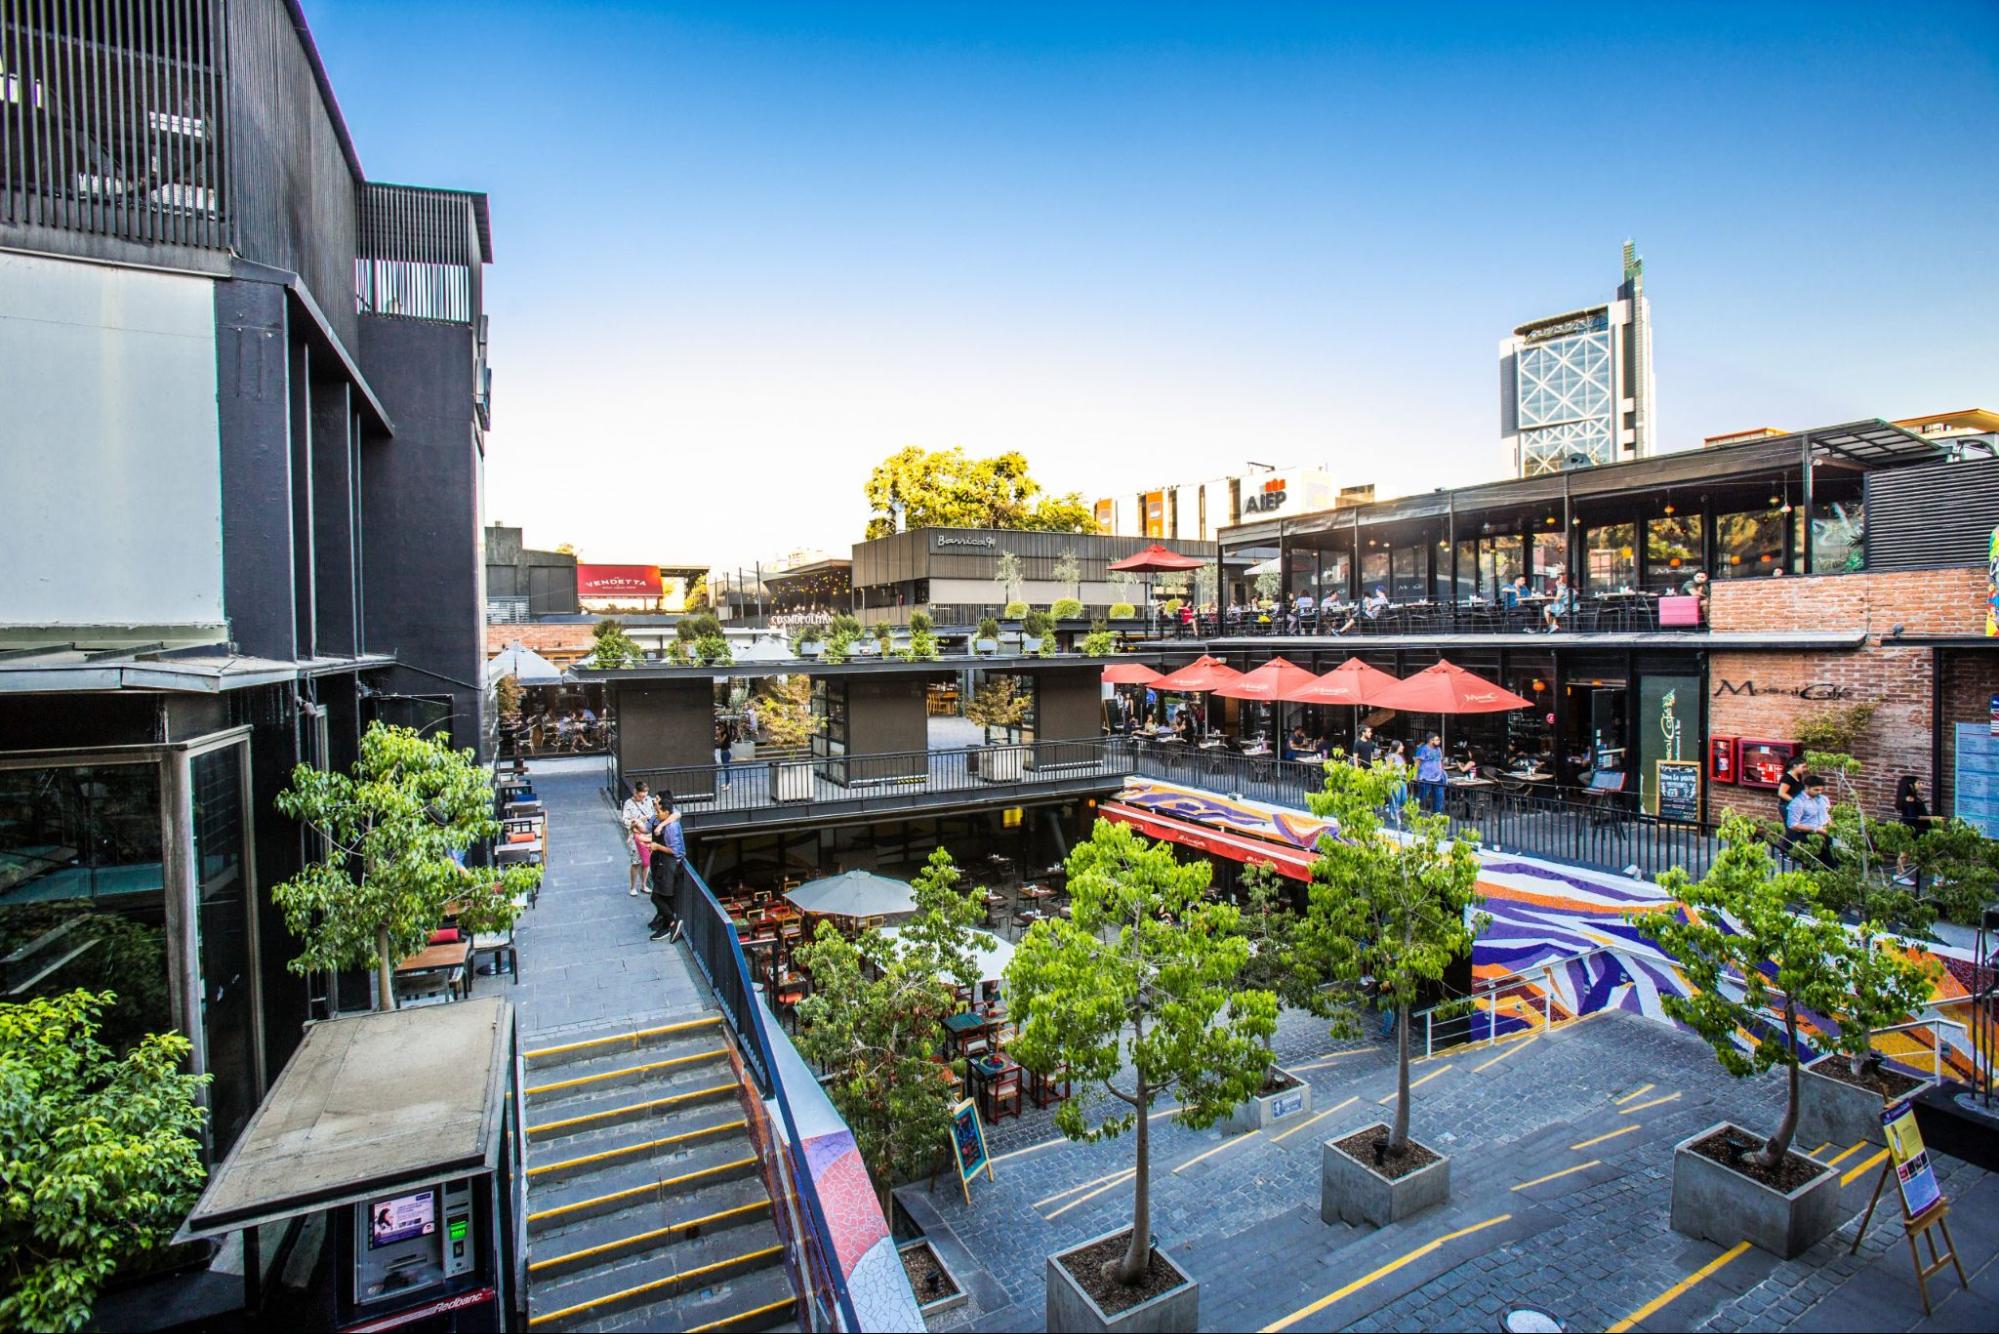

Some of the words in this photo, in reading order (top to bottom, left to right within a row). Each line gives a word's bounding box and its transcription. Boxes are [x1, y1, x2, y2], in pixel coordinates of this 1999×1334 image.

[1245, 491, 1287, 513] AIEP
[585, 579, 647, 588] VENDETTA
[433, 1292, 482, 1313] Redbanc
